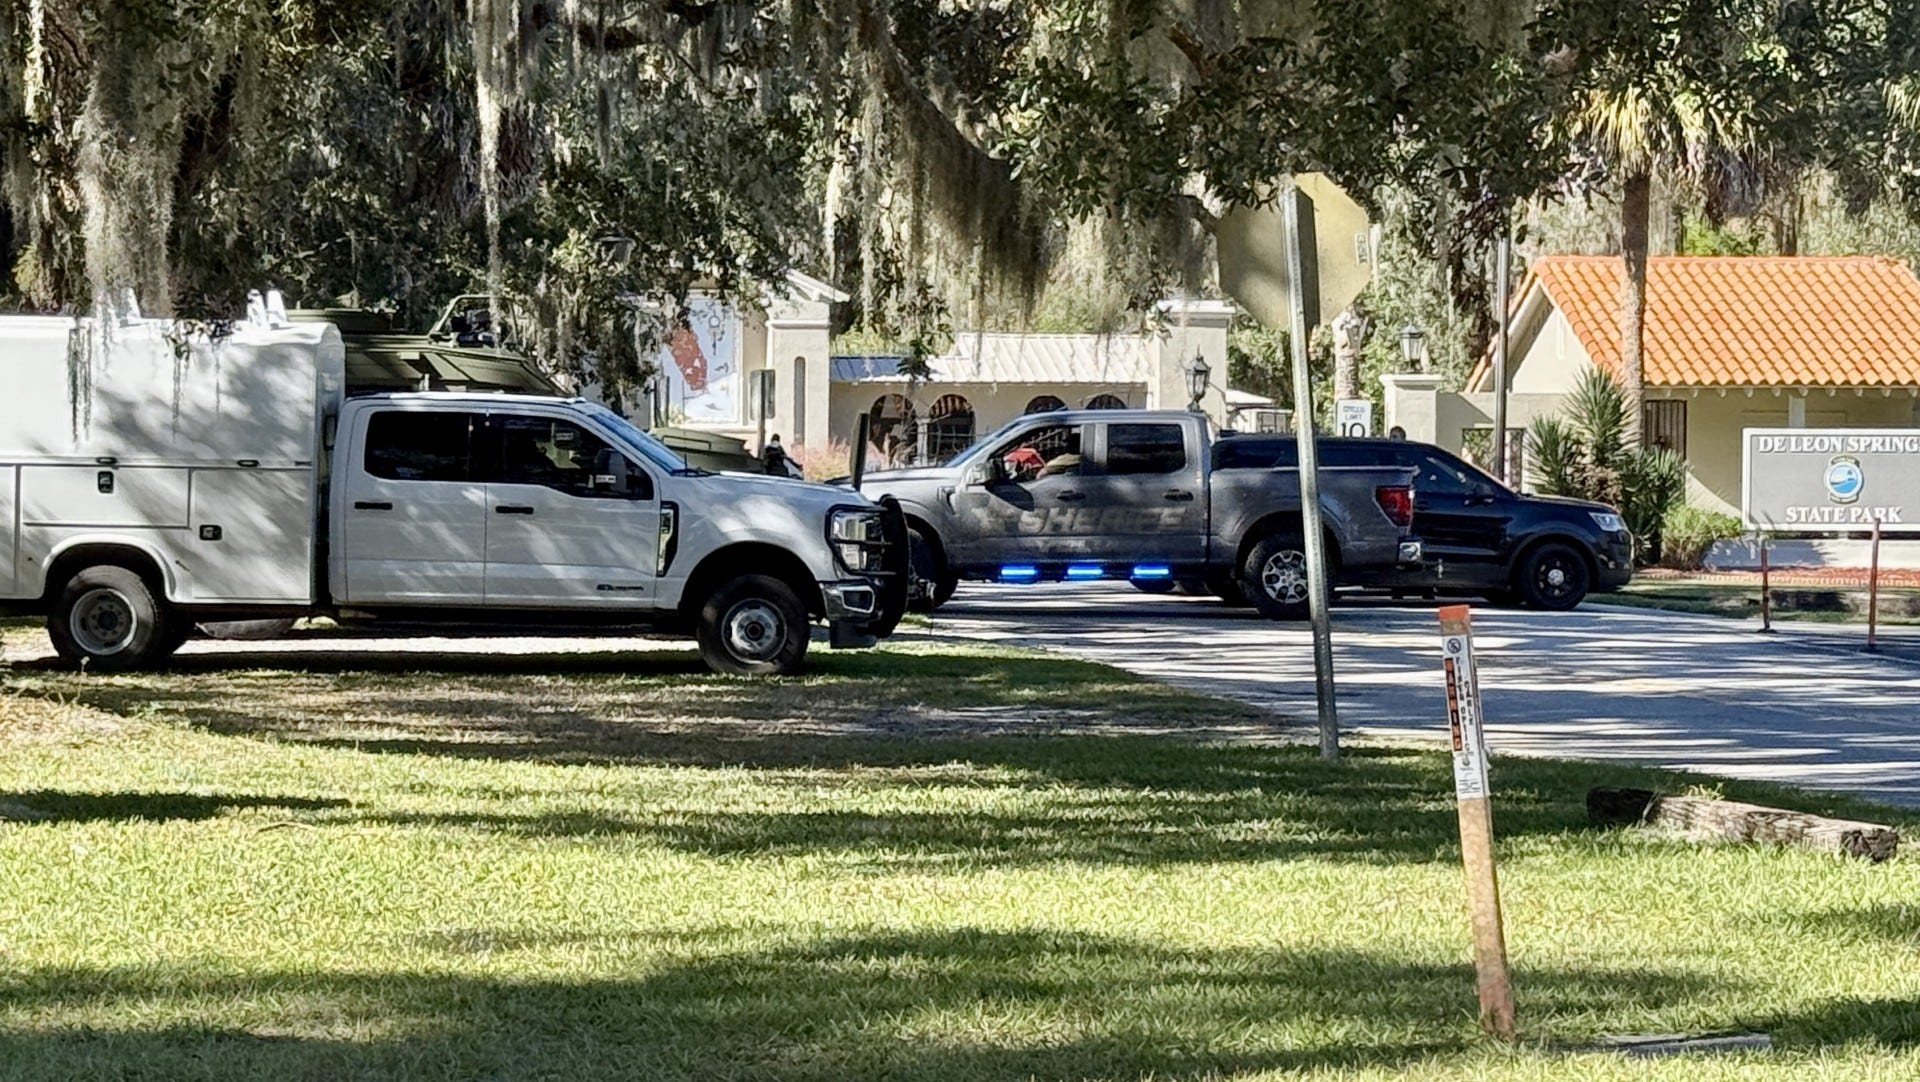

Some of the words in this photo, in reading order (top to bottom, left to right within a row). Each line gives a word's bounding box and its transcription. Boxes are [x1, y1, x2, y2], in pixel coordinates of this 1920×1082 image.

[1341, 422, 1366, 439] 10
[1759, 436, 1786, 452] DE
[1789, 436, 1843, 452] LEON
[1847, 436, 1920, 453] SPRING
[1018, 507, 1187, 533] SHERIFF
[1786, 506, 1846, 523] STATE
[1850, 506, 1901, 523] PARK
